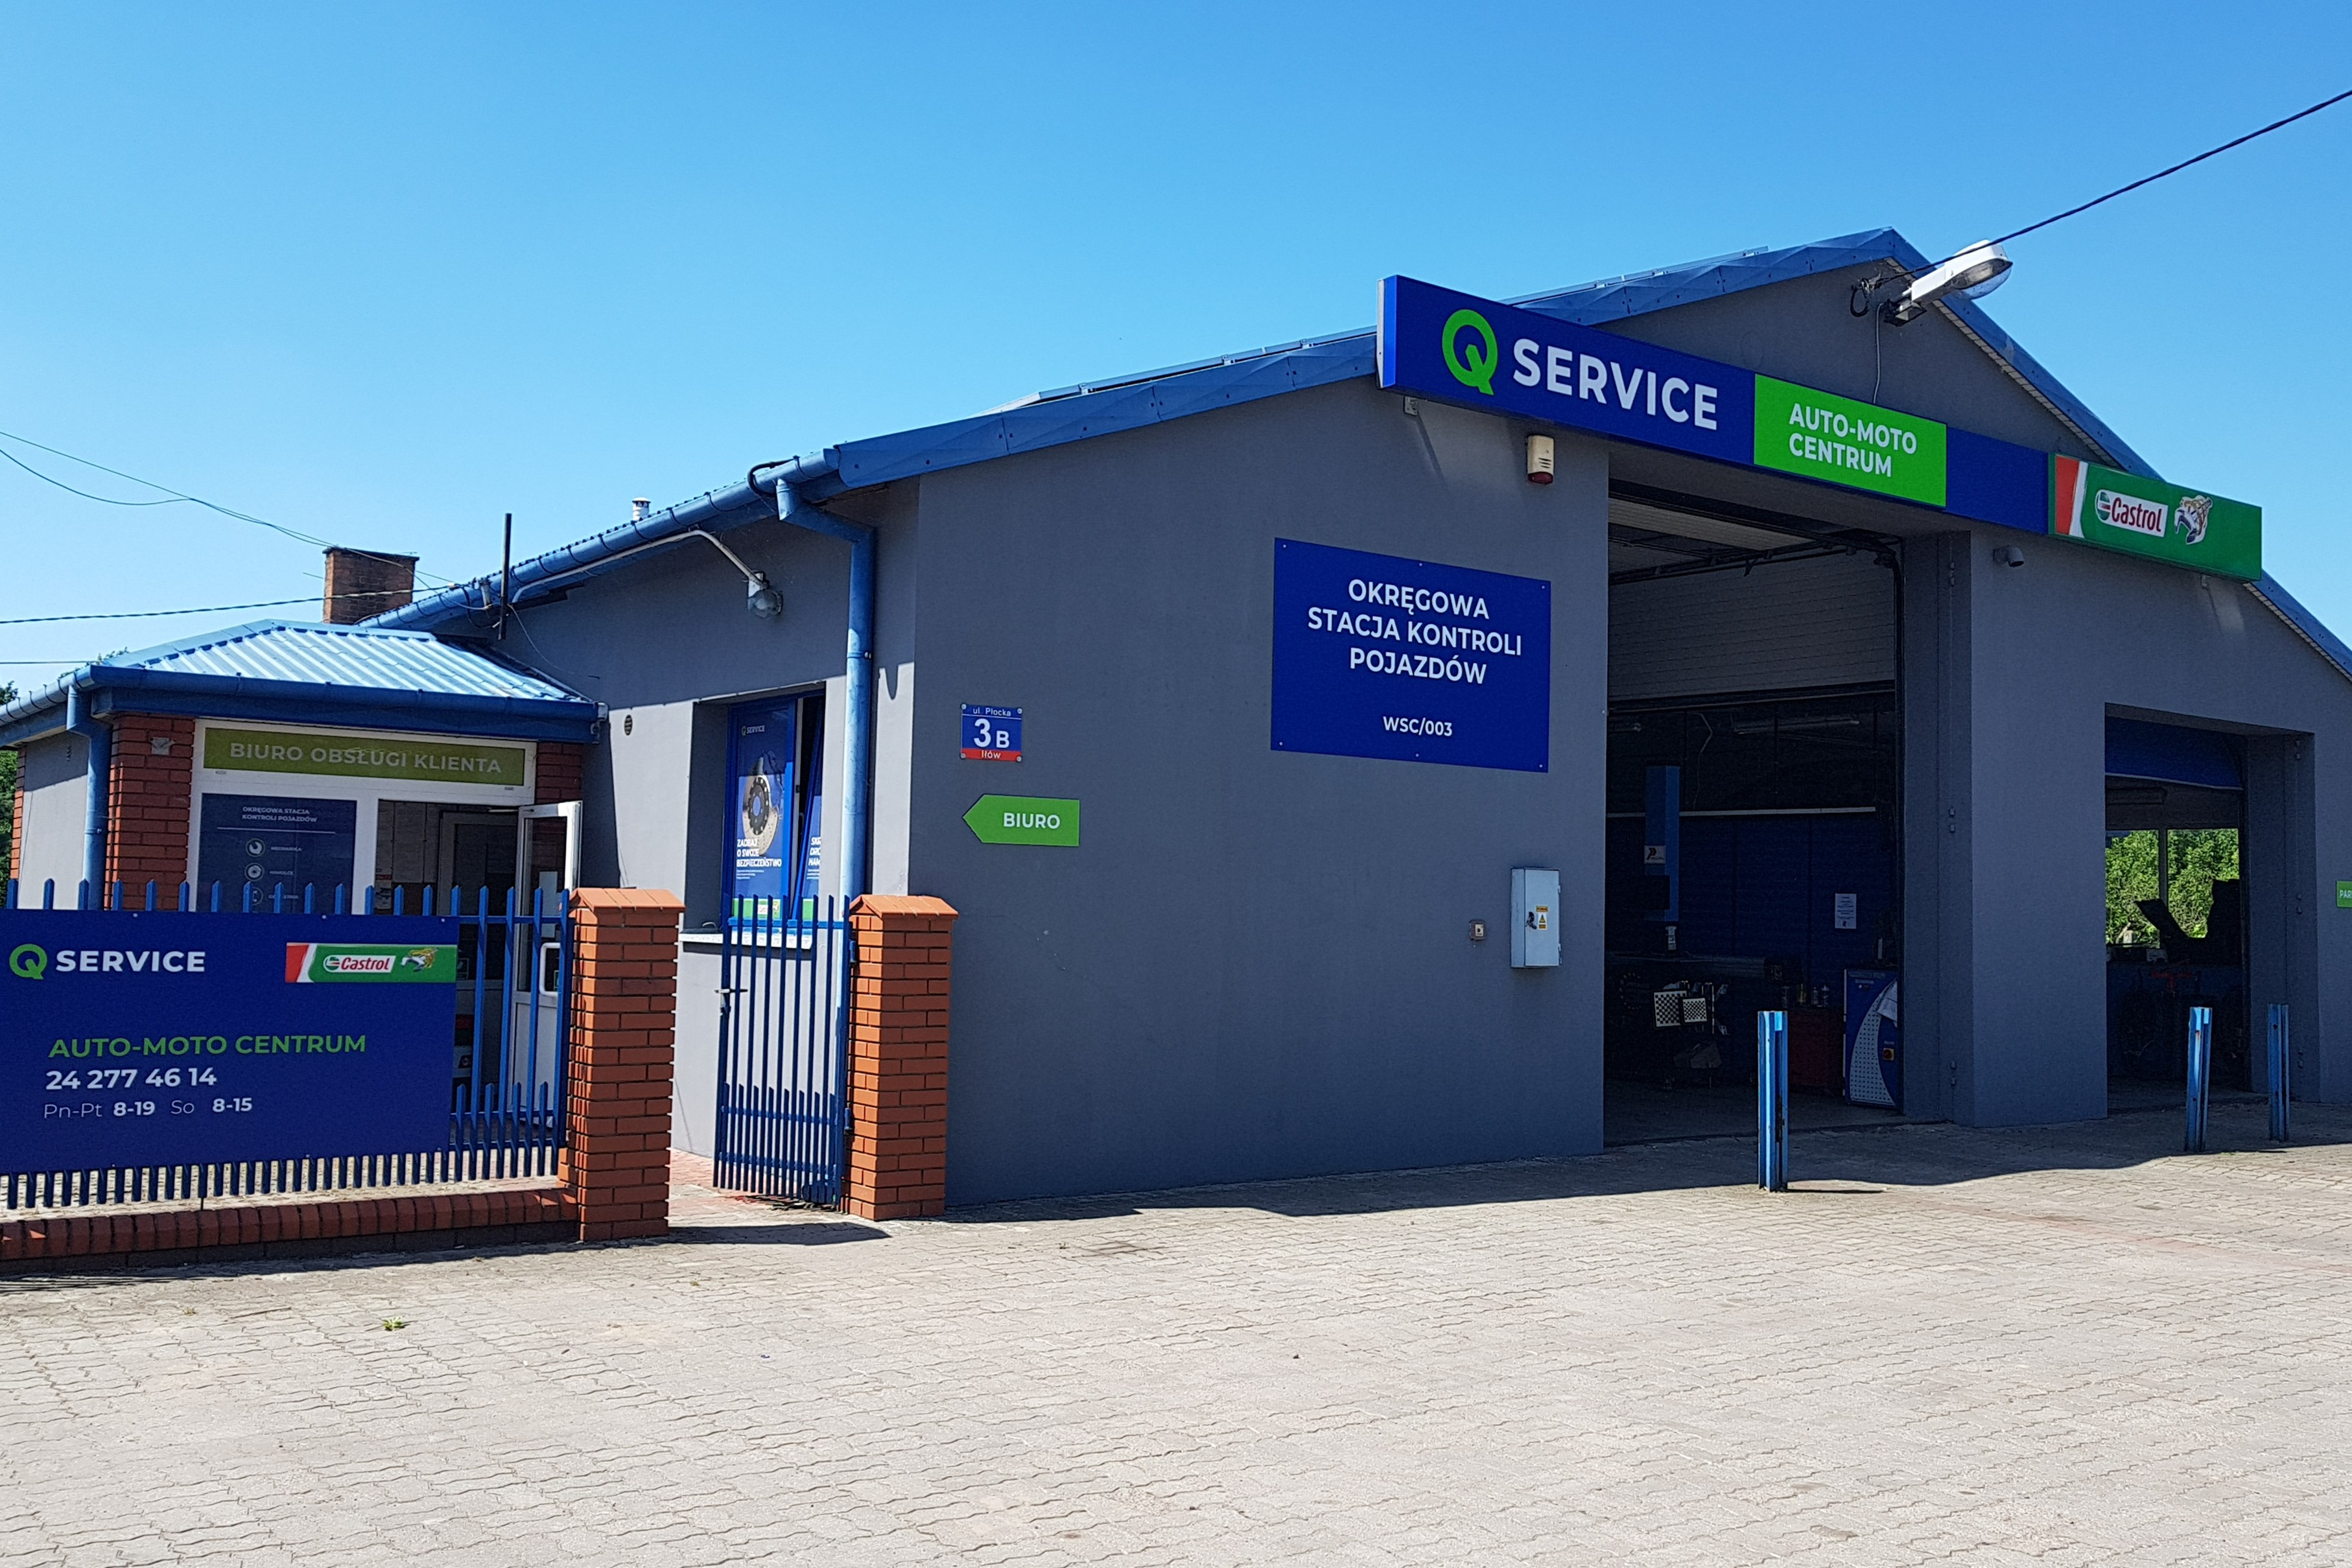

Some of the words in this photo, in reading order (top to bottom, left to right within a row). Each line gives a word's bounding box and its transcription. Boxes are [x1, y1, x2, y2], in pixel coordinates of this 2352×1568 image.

[1442, 309, 1498, 395] Q
[1513, 338, 1718, 430] SERVICE
[1789, 403, 1917, 454] AUTO-MOTO
[1789, 432, 1892, 477] CENTRUM
[2111, 497, 2162, 532] Castrol
[1348, 579, 1489, 620] OKRĘGOWA
[1308, 607, 1400, 640] STACJA
[1407, 621, 1522, 656] KONTROLI
[1350, 648, 1487, 685] POJAZDÓW
[1383, 716, 1453, 736] WSC/003
[230, 743, 302, 761] BIURO
[311, 747, 407, 767] OBSŁUGI
[414, 754, 502, 773] KLIENTA
[1004, 812, 1061, 829] BIURO
[736, 849, 741, 858] O
[9, 944, 47, 979] Q
[56, 950, 206, 972] SERVICE
[341, 957, 390, 970] Castrol
[48, 1036, 227, 1058] AUTO-MOTO
[235, 1035, 366, 1054] CENTRUM
[45, 1070, 80, 1090] 24
[87, 1069, 137, 1089] 277
[145, 1068, 181, 1087] 46
[188, 1068, 217, 1086] 14
[44, 1103, 102, 1118] Pn-Pt
[113, 1101, 155, 1116] 8-19
[171, 1100, 194, 1114] So
[212, 1097, 253, 1112] 8-15
